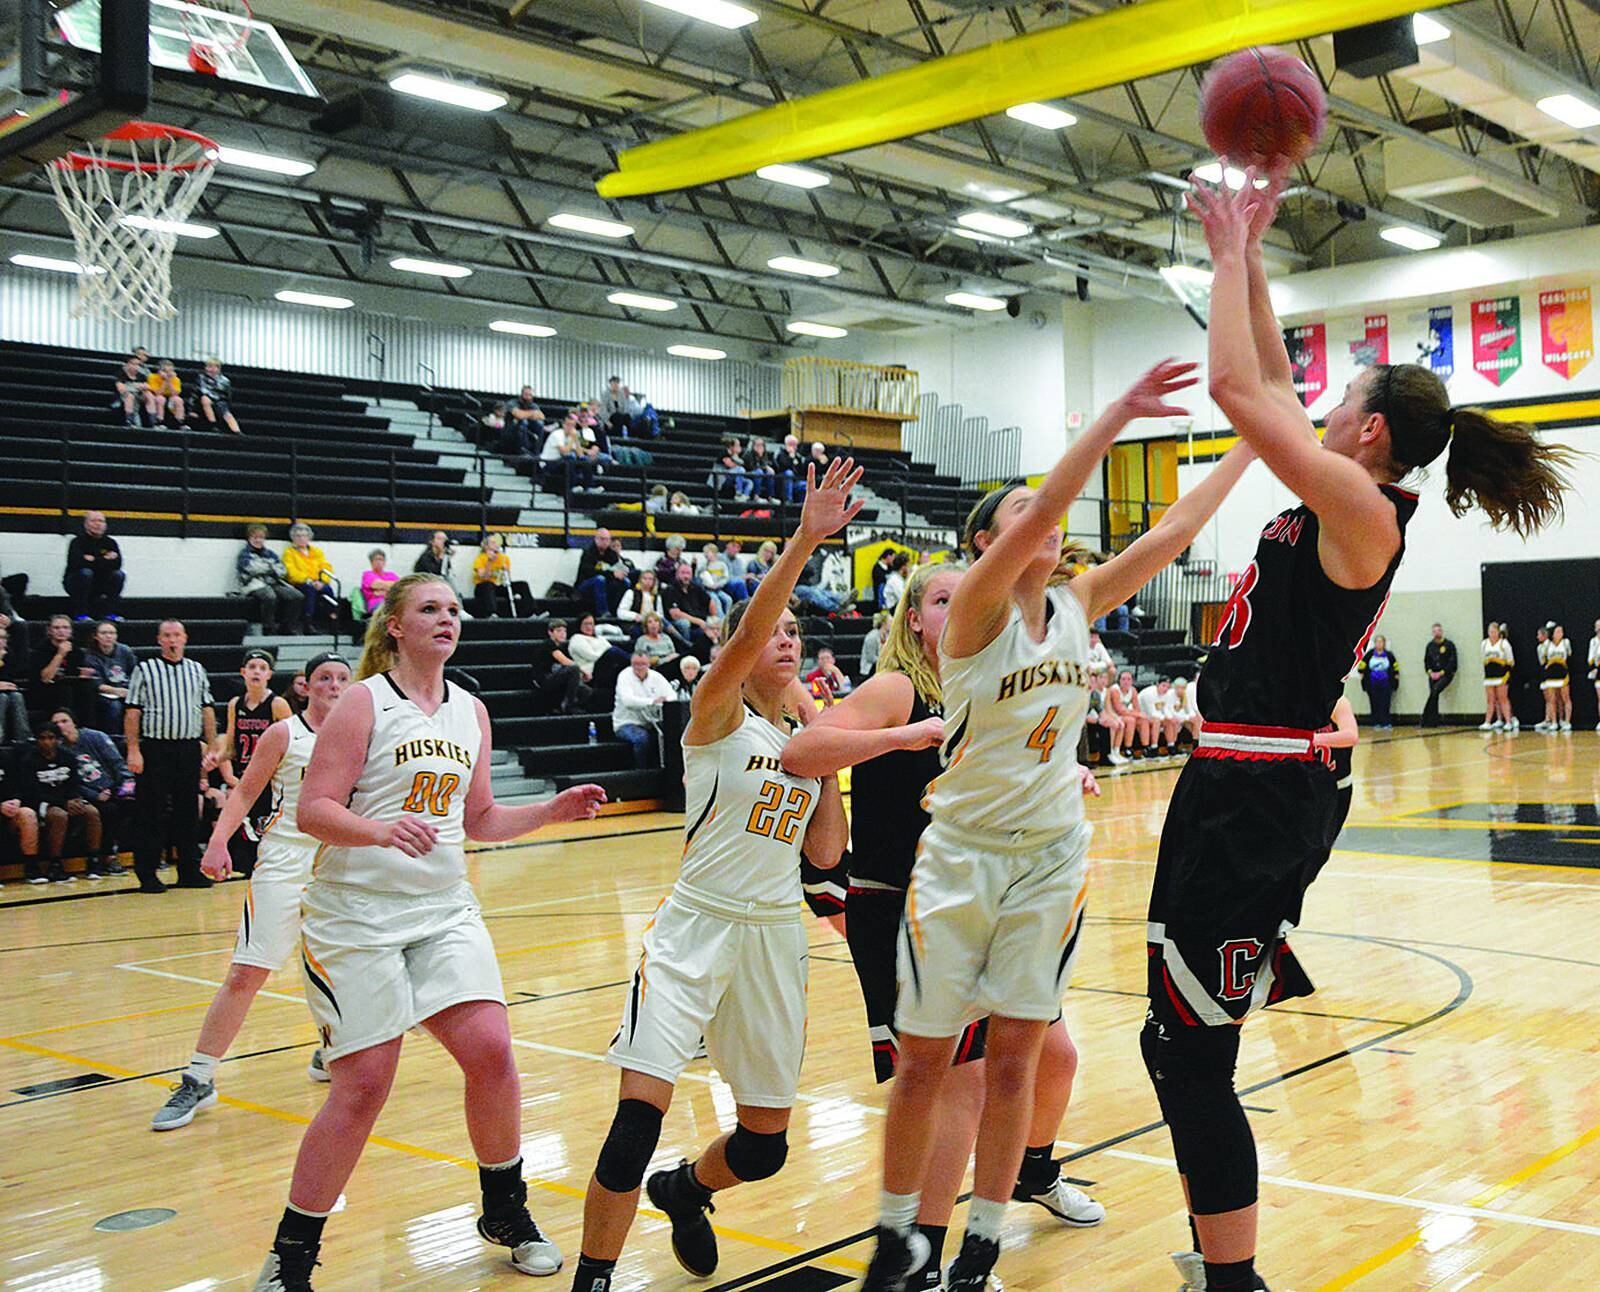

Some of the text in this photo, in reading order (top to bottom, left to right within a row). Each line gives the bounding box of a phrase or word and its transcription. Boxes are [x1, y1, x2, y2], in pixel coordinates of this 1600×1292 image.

[394, 739, 472, 769] HUSKIES
[1025, 705, 1059, 764] 4
[401, 771, 460, 817] 00
[745, 780, 812, 845] 22
[1216, 938, 1264, 1001] C
